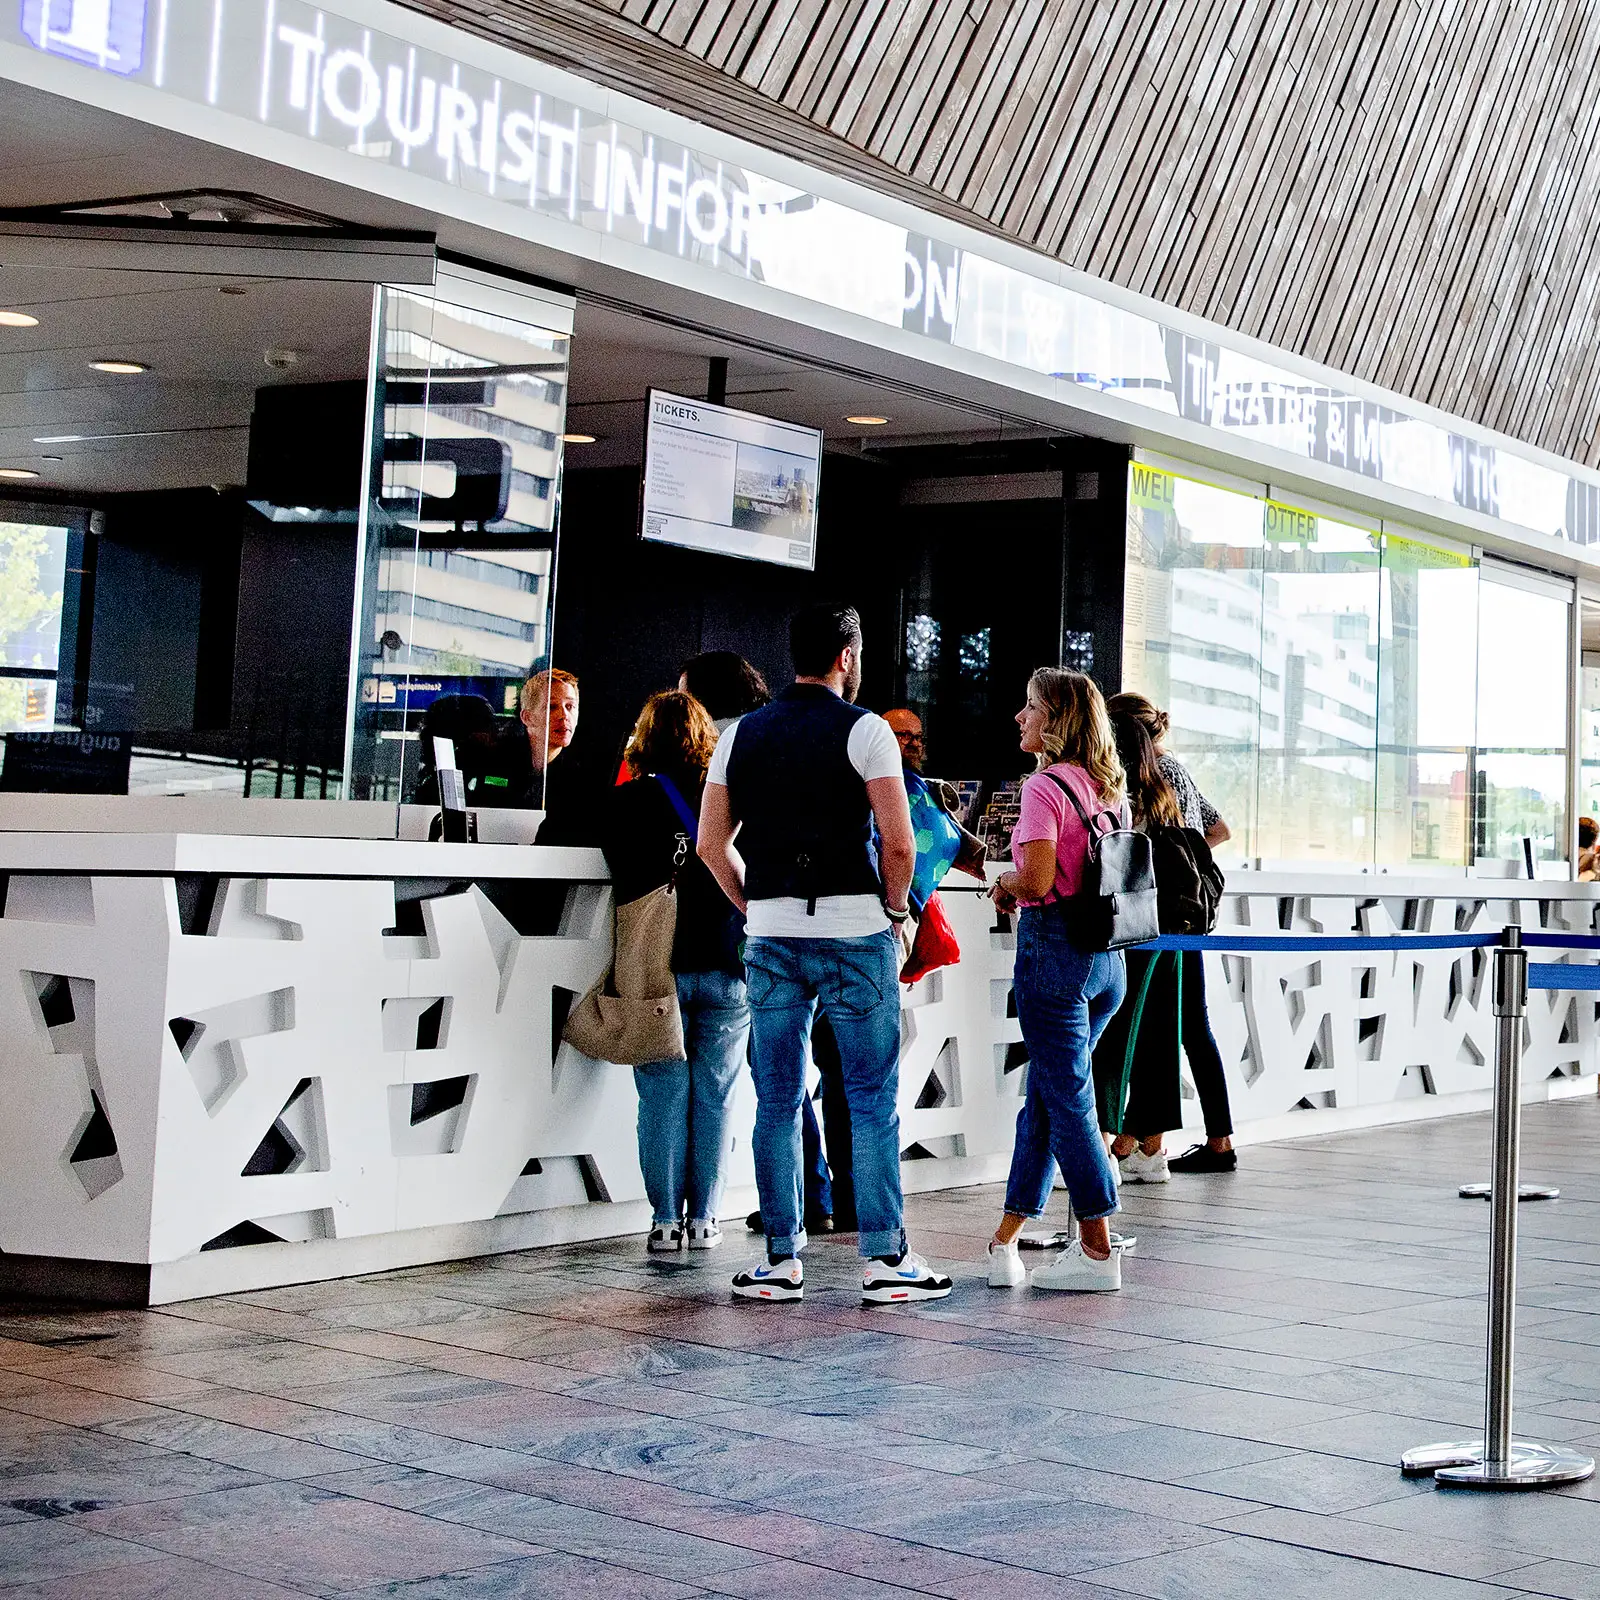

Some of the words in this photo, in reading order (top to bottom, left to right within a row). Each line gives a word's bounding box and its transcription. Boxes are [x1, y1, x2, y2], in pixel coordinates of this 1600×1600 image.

[279, 25, 575, 196] TOURIST
[594, 140, 958, 326] INFORON
[654, 401, 701, 422] TICKETS.
[1326, 404, 1347, 455] &
[1132, 466, 1174, 502] WEL
[1266, 504, 1317, 543] OTTER
